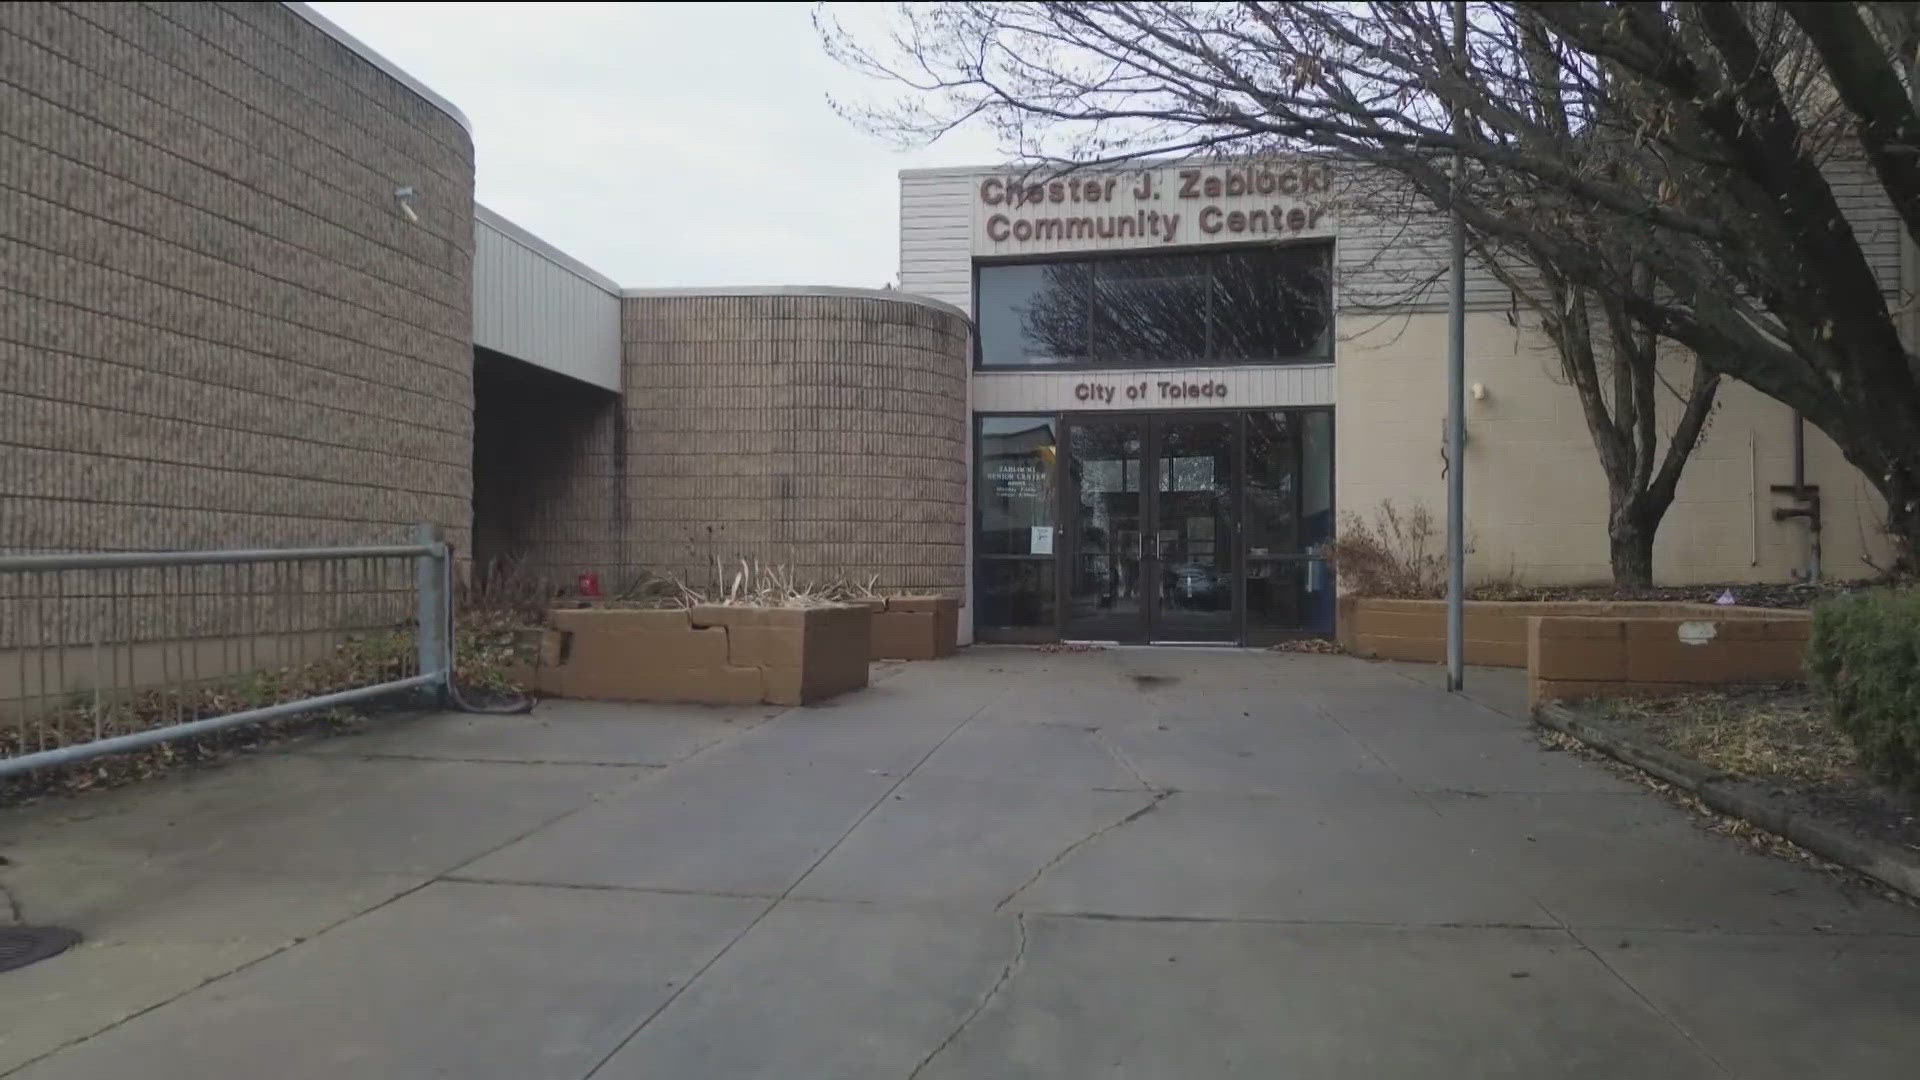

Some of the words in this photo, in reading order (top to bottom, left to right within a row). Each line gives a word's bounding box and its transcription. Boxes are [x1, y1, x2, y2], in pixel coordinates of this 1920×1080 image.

[980, 176, 1116, 206] Chester
[1134, 172, 1160, 200] J.
[1179, 166, 1334, 198] Zablocki
[986, 208, 1180, 242] Community
[1199, 203, 1325, 234] Center
[1075, 383, 1115, 404] City
[1126, 382, 1147, 399] of
[1157, 380, 1228, 399] Toledo
